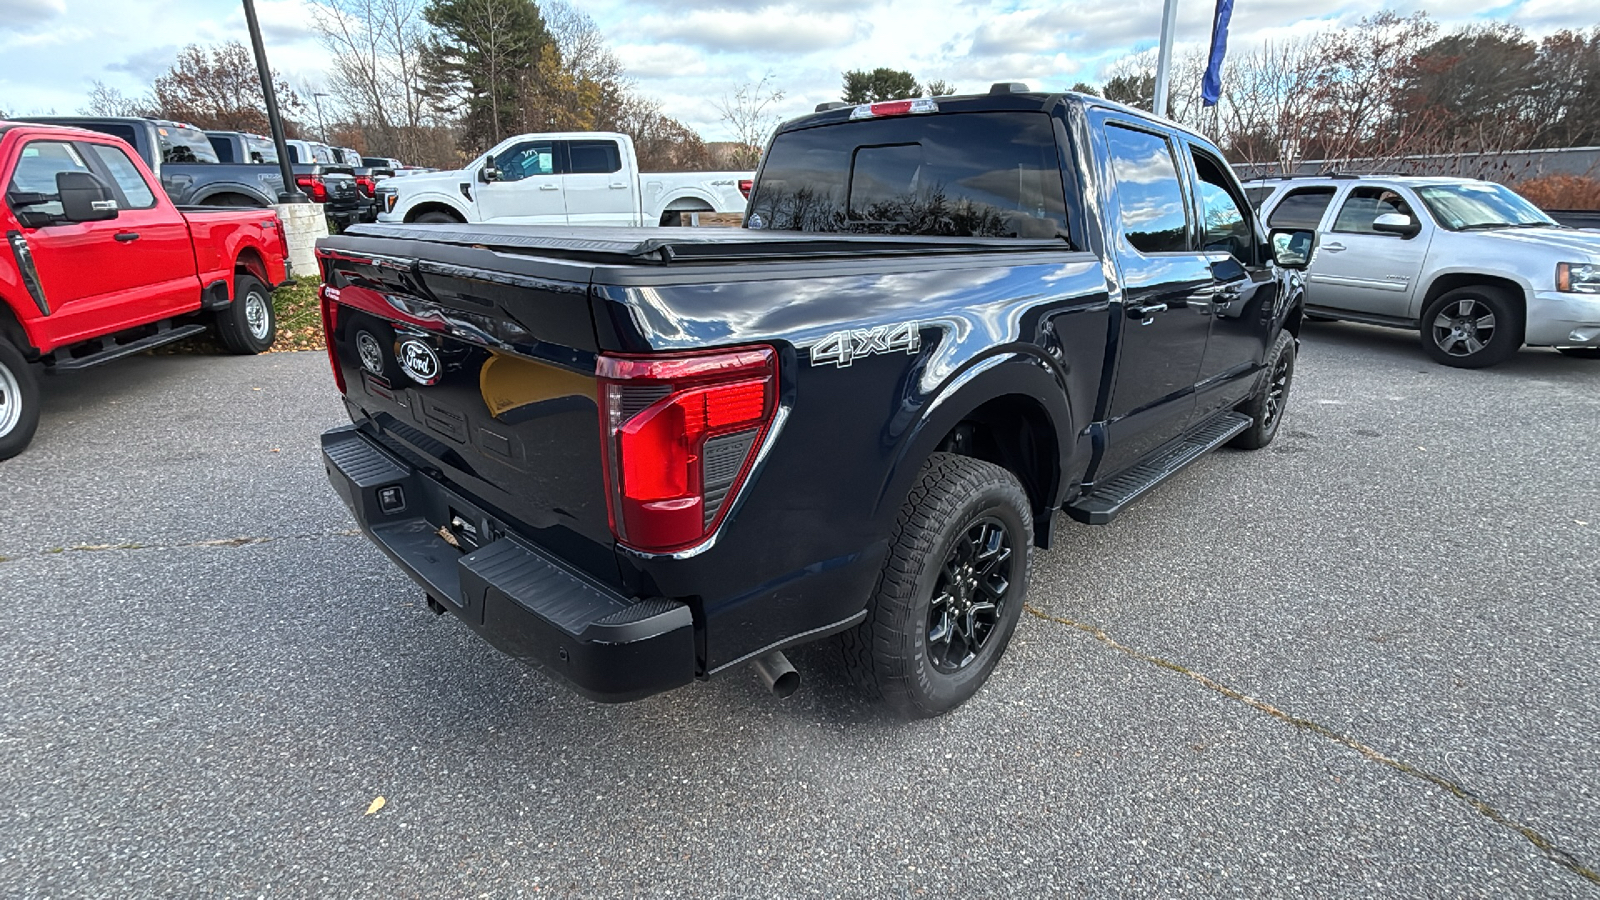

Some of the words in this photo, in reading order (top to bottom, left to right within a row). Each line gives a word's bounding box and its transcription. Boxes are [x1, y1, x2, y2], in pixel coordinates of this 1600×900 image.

[406, 344, 430, 374] Ford
[706, 442, 743, 455] FORD
[914, 618, 938, 701] RANGLER
